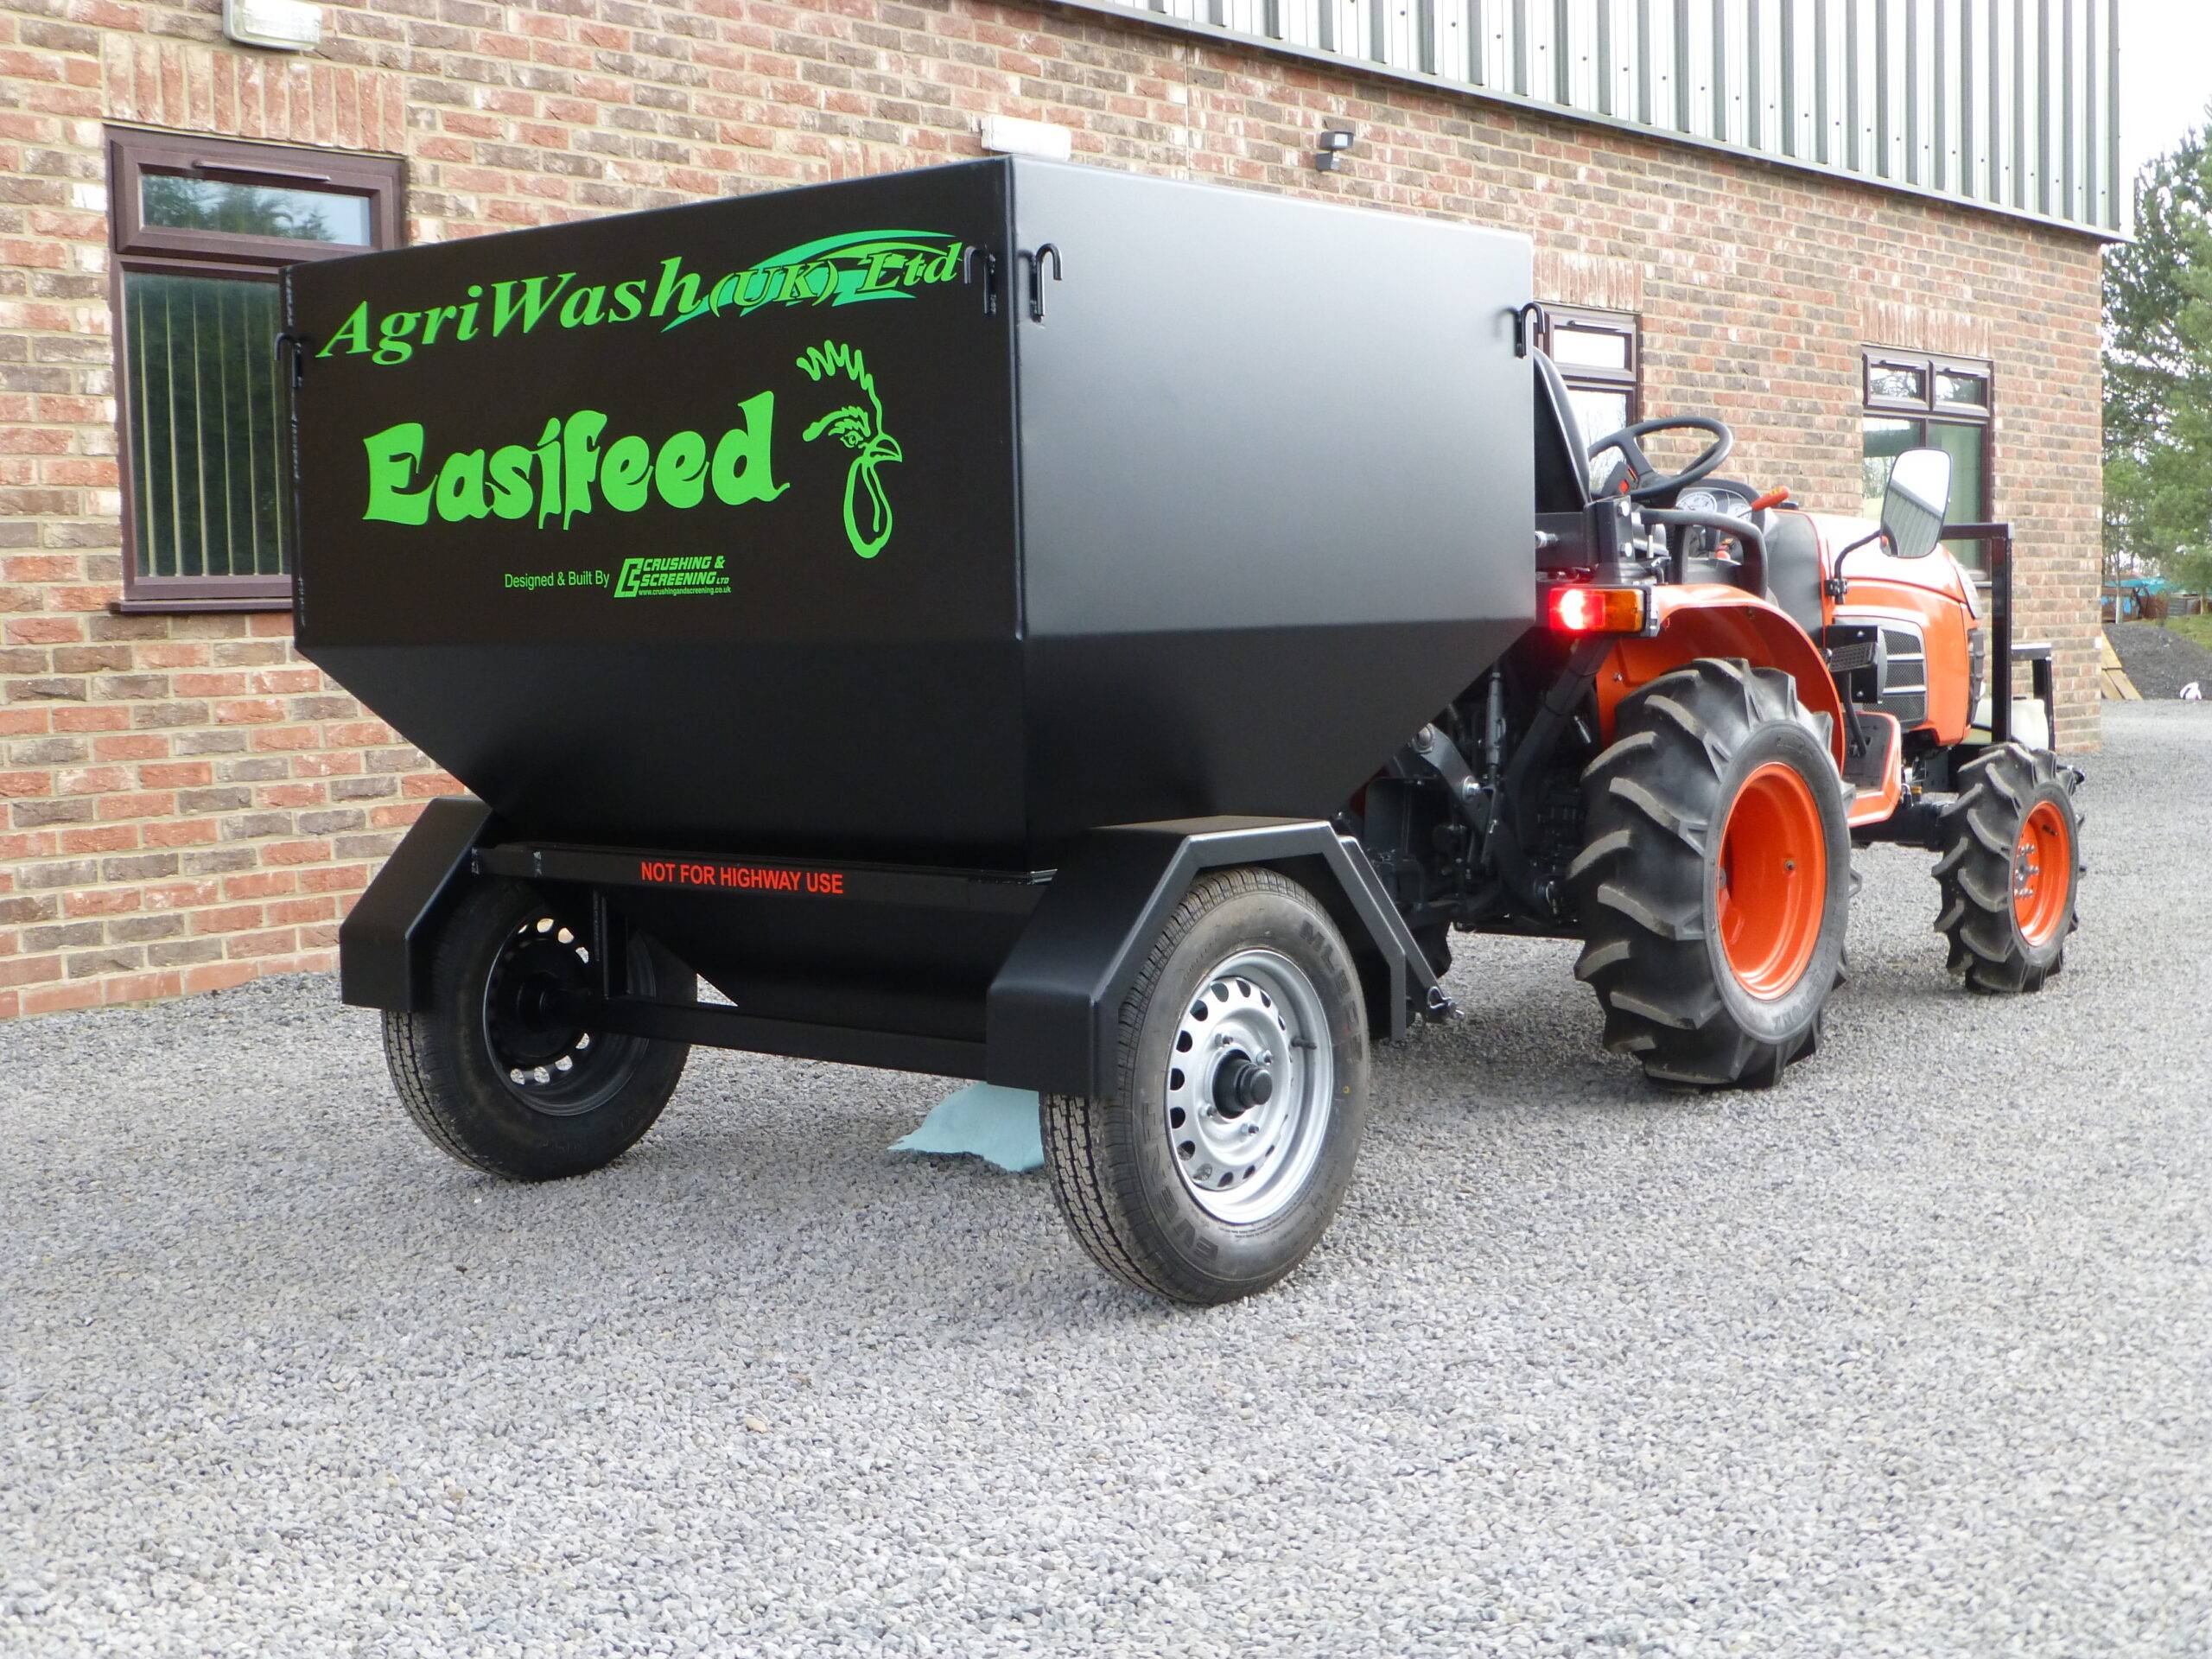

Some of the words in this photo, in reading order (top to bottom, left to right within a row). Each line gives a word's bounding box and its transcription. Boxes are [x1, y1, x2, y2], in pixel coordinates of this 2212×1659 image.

[316, 256, 704, 365] AgriWash
[856, 242, 963, 295] Ltd
[362, 390, 791, 531] Easifeed
[643, 556, 712, 571] CRUSHING
[714, 556, 726, 569] &
[505, 572, 554, 590] Designed
[557, 572, 565, 585] &
[568, 571, 592, 586] Built
[594, 569, 610, 588] By
[639, 571, 717, 587] SCREENING
[638, 586, 732, 596] www.crushingandscreening.co.uk
[641, 861, 676, 882] NOT
[680, 863, 716, 885] FOR
[720, 867, 801, 891] HIGHWAY
[806, 872, 843, 894] USE
